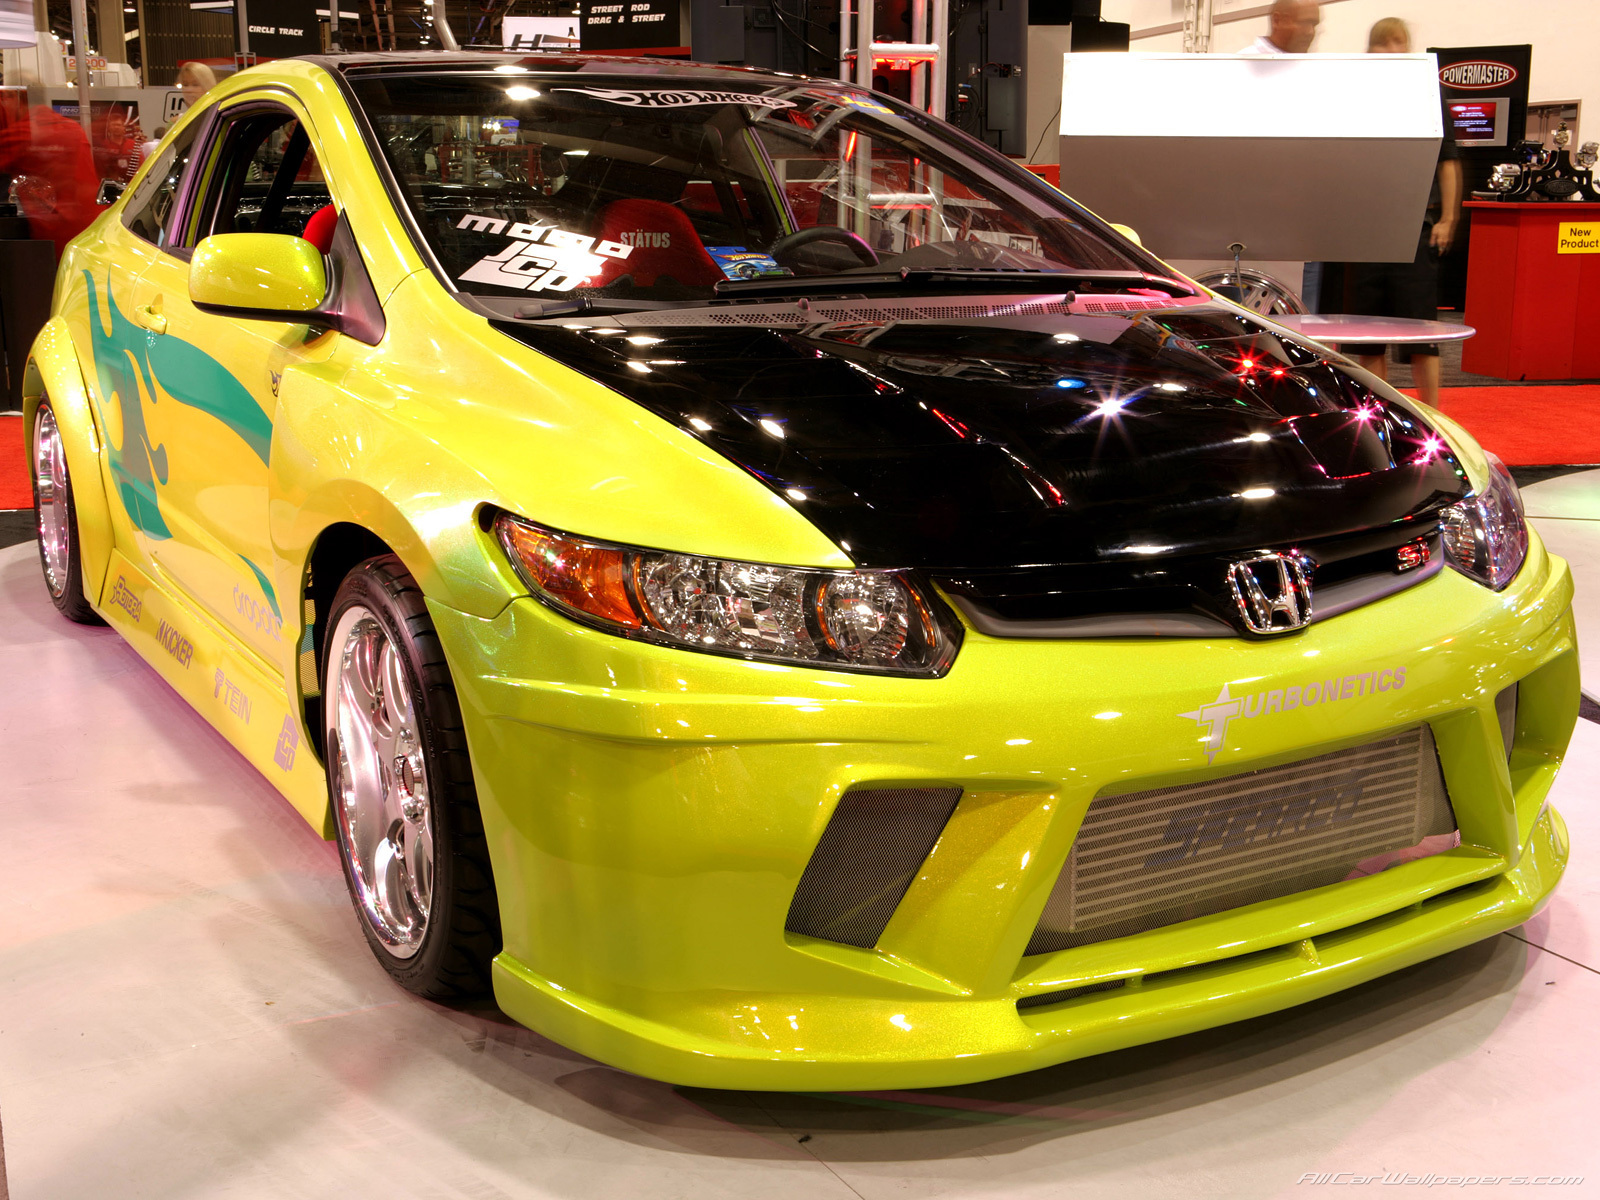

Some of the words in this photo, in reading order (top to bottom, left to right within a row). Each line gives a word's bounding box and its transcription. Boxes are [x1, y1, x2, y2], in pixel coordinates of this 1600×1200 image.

[591, 5, 623, 14] STREET
[631, 3, 650, 12] ROD
[587, 16, 612, 25] DRAG
[632, 13, 665, 23] STREET
[249, 25, 275, 34] CIRCLE
[278, 27, 304, 36] TRACK
[1443, 64, 1510, 84] POWERMASTER
[1570, 228, 1591, 237] New
[1560, 239, 1599, 248] Product
[159, 620, 194, 670] KICKER
[223, 677, 253, 725] TEIN
